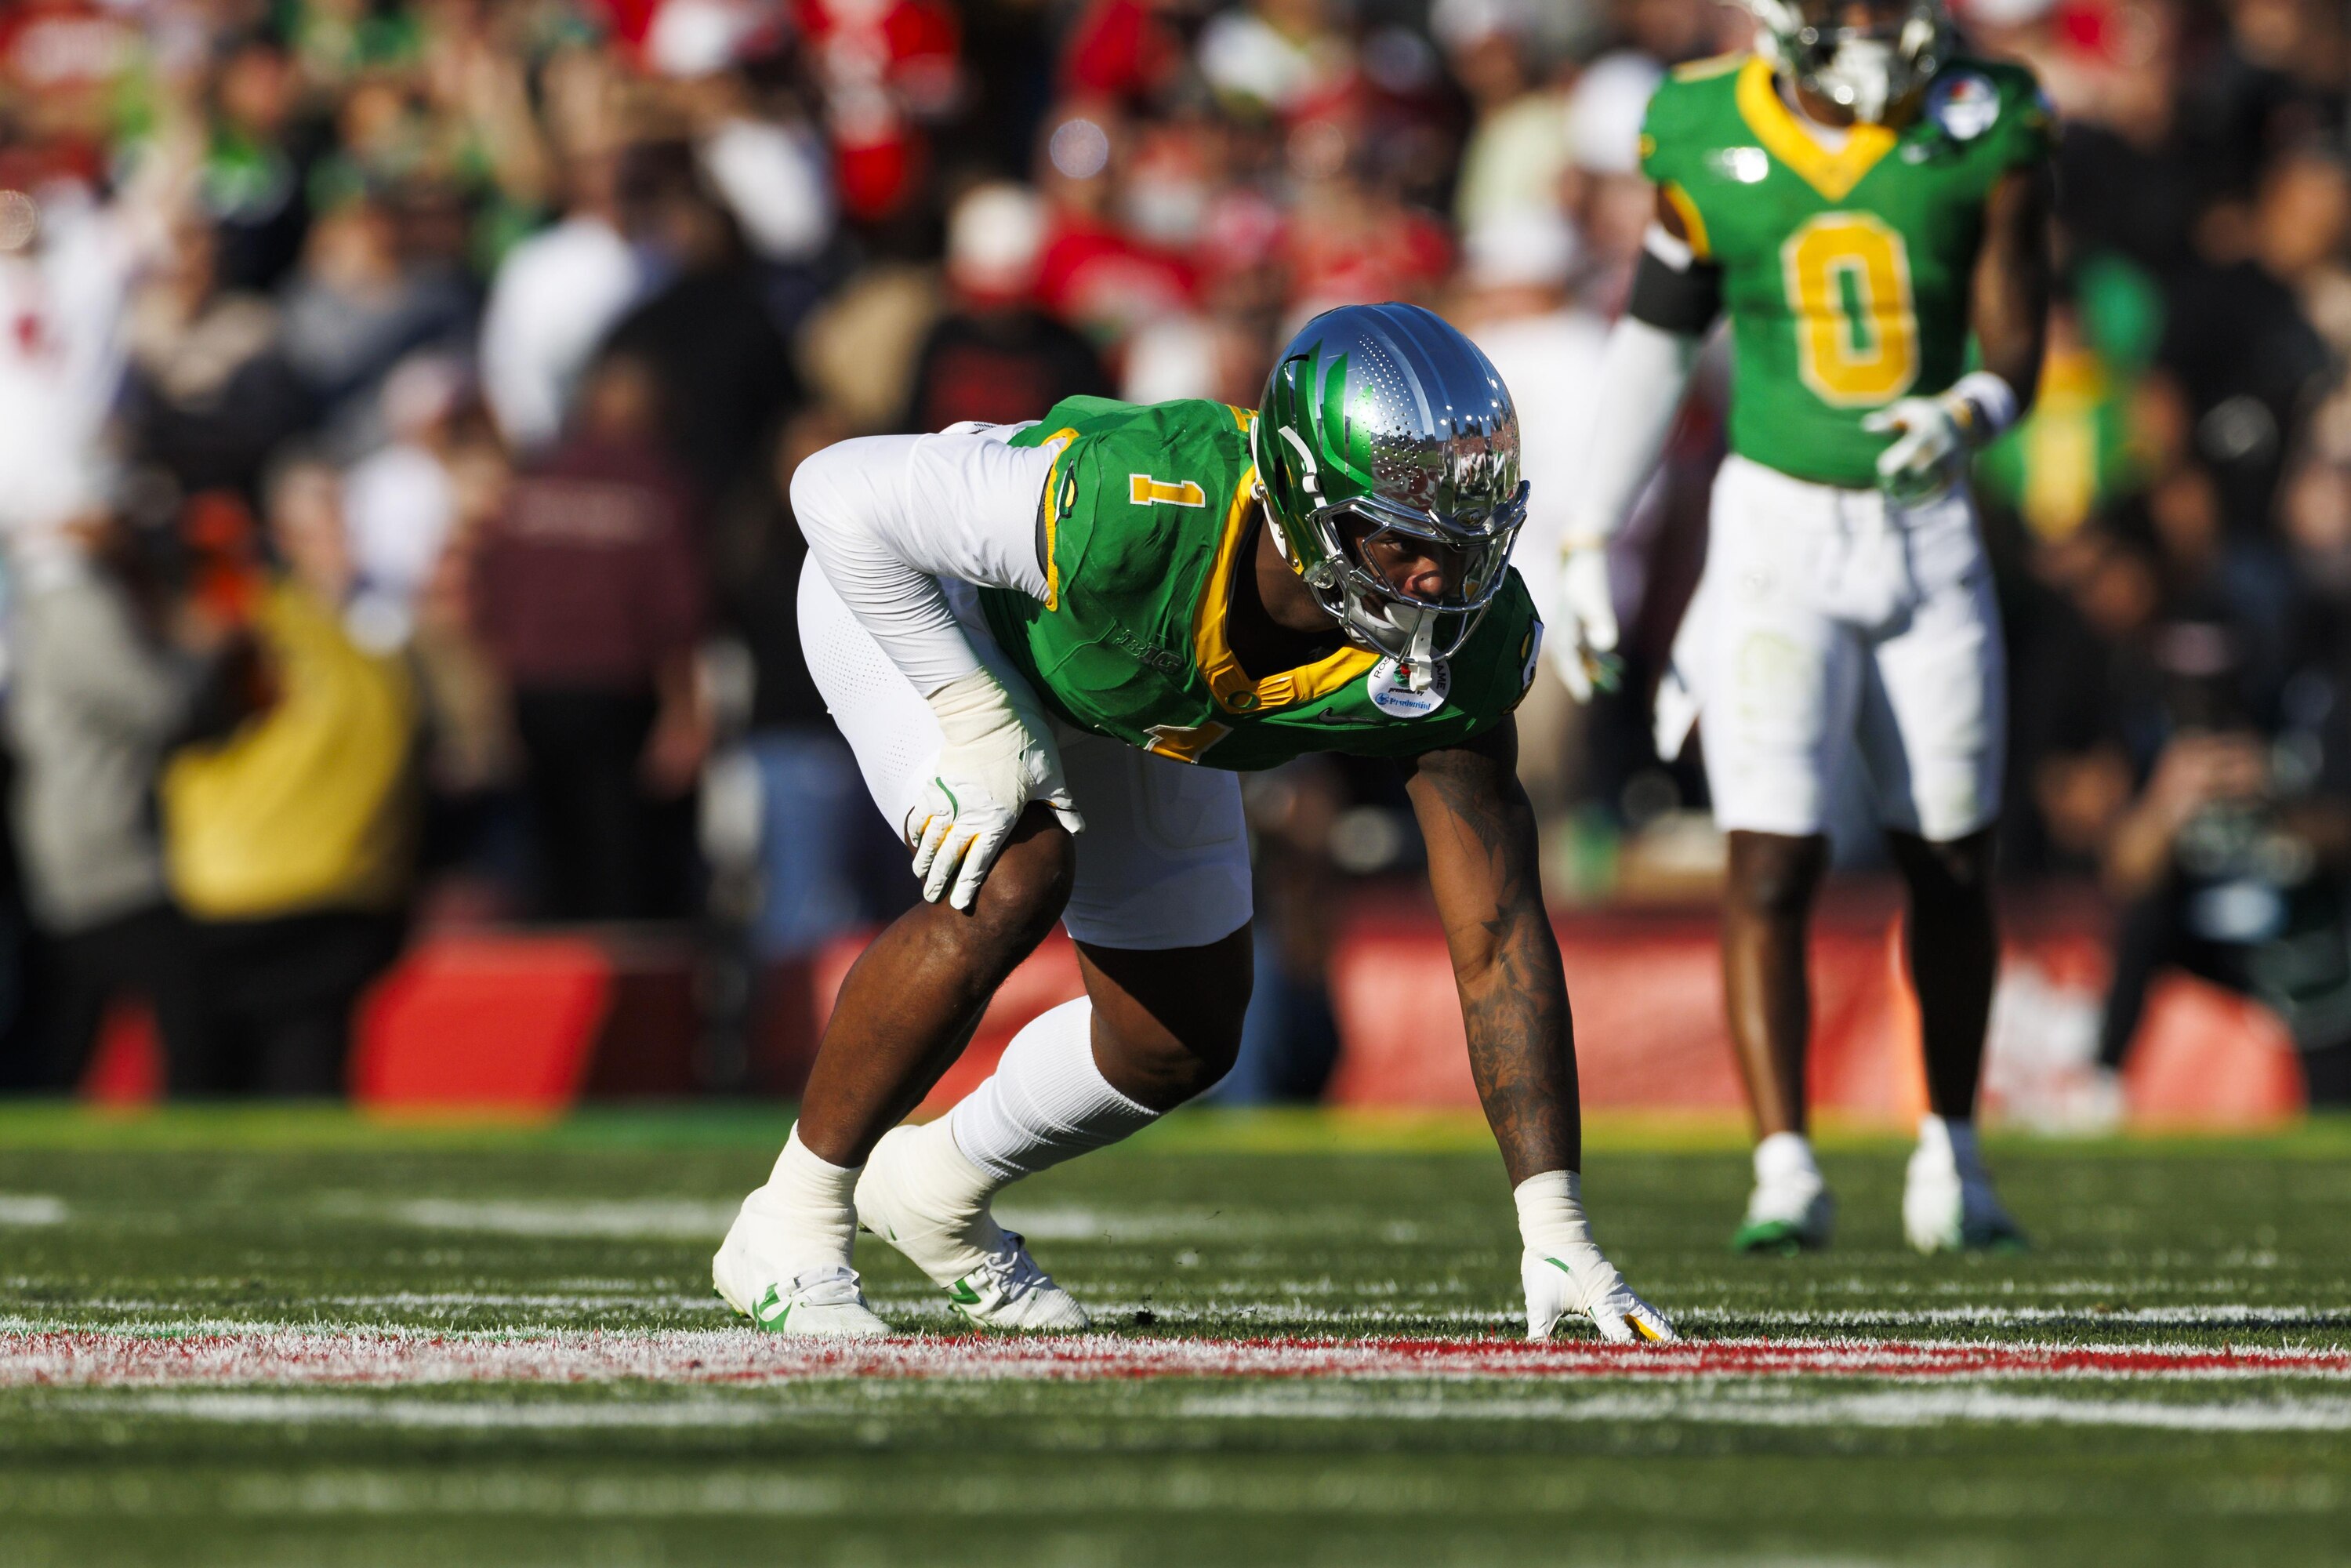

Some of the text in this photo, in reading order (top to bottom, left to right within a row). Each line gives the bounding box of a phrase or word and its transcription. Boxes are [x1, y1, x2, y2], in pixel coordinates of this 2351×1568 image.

[1780, 211, 1920, 408] 0
[1129, 474, 1206, 508] 1
[1373, 656, 1446, 690] ROS AME
[1389, 697, 1431, 710] Prudential
